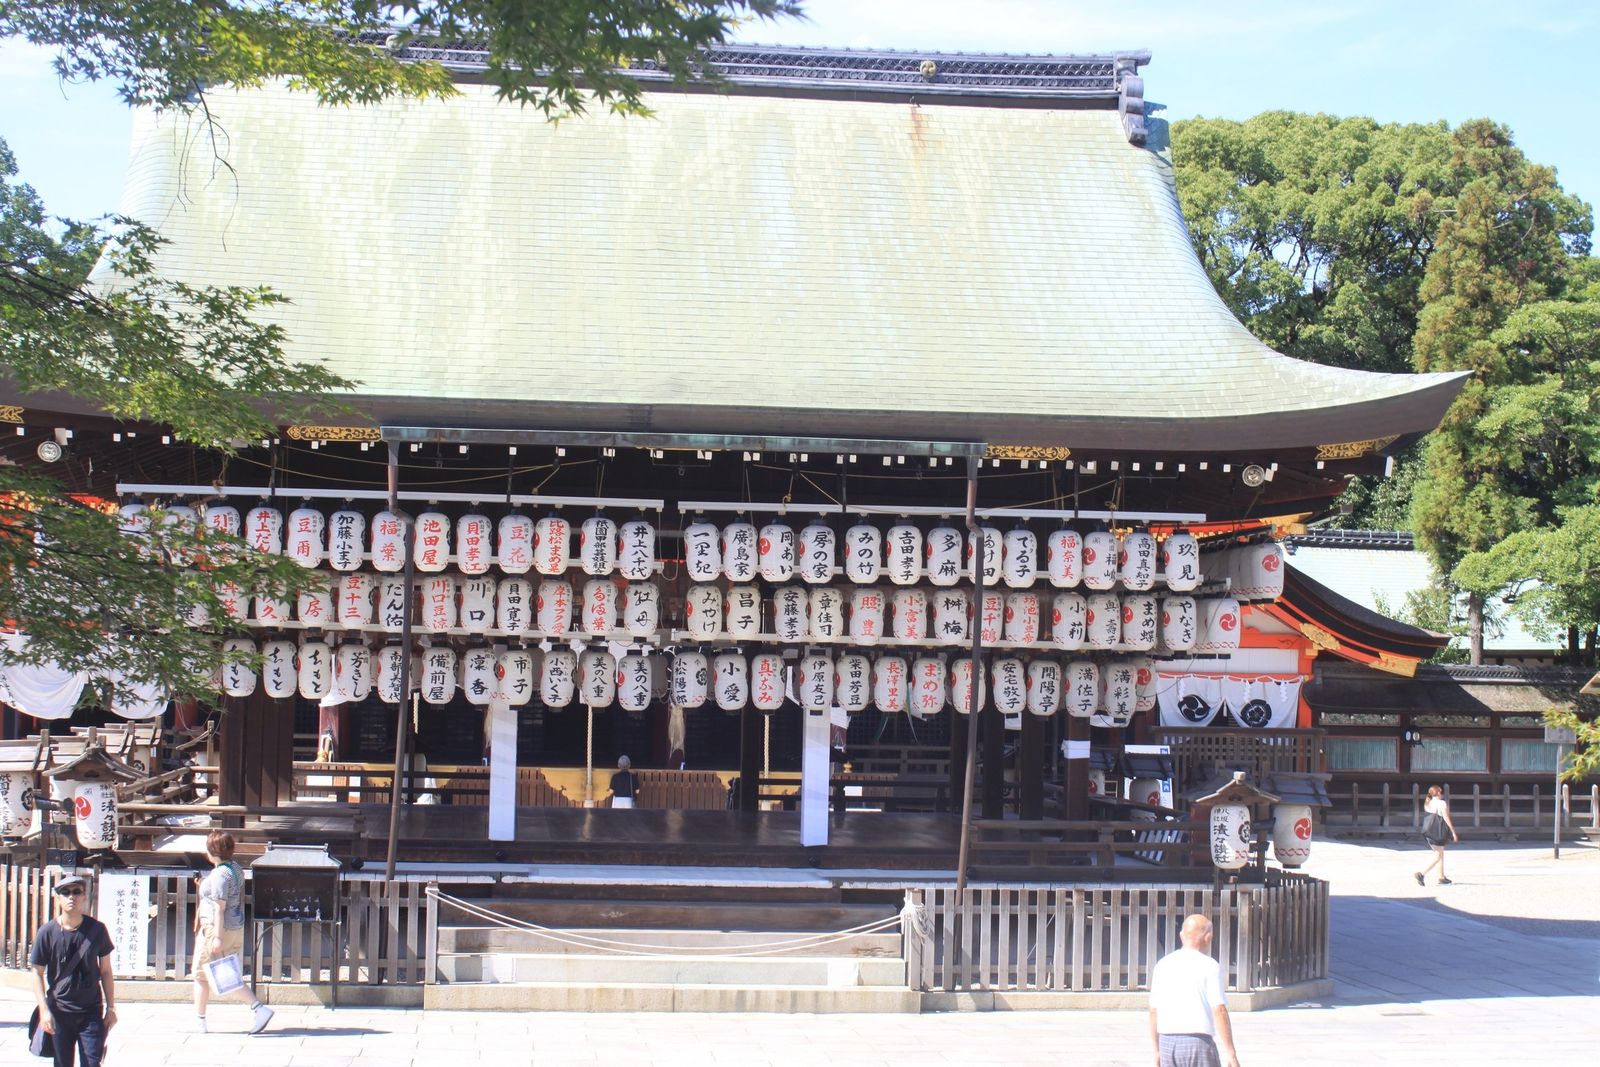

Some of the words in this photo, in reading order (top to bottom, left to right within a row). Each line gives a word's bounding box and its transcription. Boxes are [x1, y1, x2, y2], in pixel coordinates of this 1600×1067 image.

[336, 514, 354, 569] 加藤小ます
[379, 520, 397, 562] 福葉
[422, 519, 441, 566] 池田屋
[509, 525, 525, 564] 豆花
[631, 525, 649, 577] 井上八千代
[780, 531, 793, 575] 岡あい
[812, 531, 828, 578] 房の家
[858, 532, 874, 575] みの竹
[938, 533, 957, 576] 多麻
[1016, 536, 1031, 578] てる子
[1061, 535, 1077, 579] 福奈美
[1136, 537, 1151, 588] 高田真知子
[386, 583, 404, 627] だん佑
[470, 582, 486, 621] 川口
[702, 591, 716, 632] みやけ
[737, 592, 754, 629] 昌子
[784, 591, 799, 639] 安藤孝子
[981, 597, 997, 643] 豆千鶴
[1179, 601, 1193, 643] やなぎ
[428, 655, 447, 700] 備前屋
[513, 657, 528, 694] 市子
[548, 658, 563, 703] 小西いく子
[592, 657, 608, 698] 美の八重
[633, 660, 649, 707] 美の八重
[812, 660, 828, 706] 伊原友己
[887, 662, 901, 710] 長澤里美
[1002, 662, 1021, 709] 安宅敬子
[1038, 666, 1056, 712] 開陽亭
[1077, 668, 1095, 712] 満佐子
[1112, 670, 1131, 716] 満彩美
